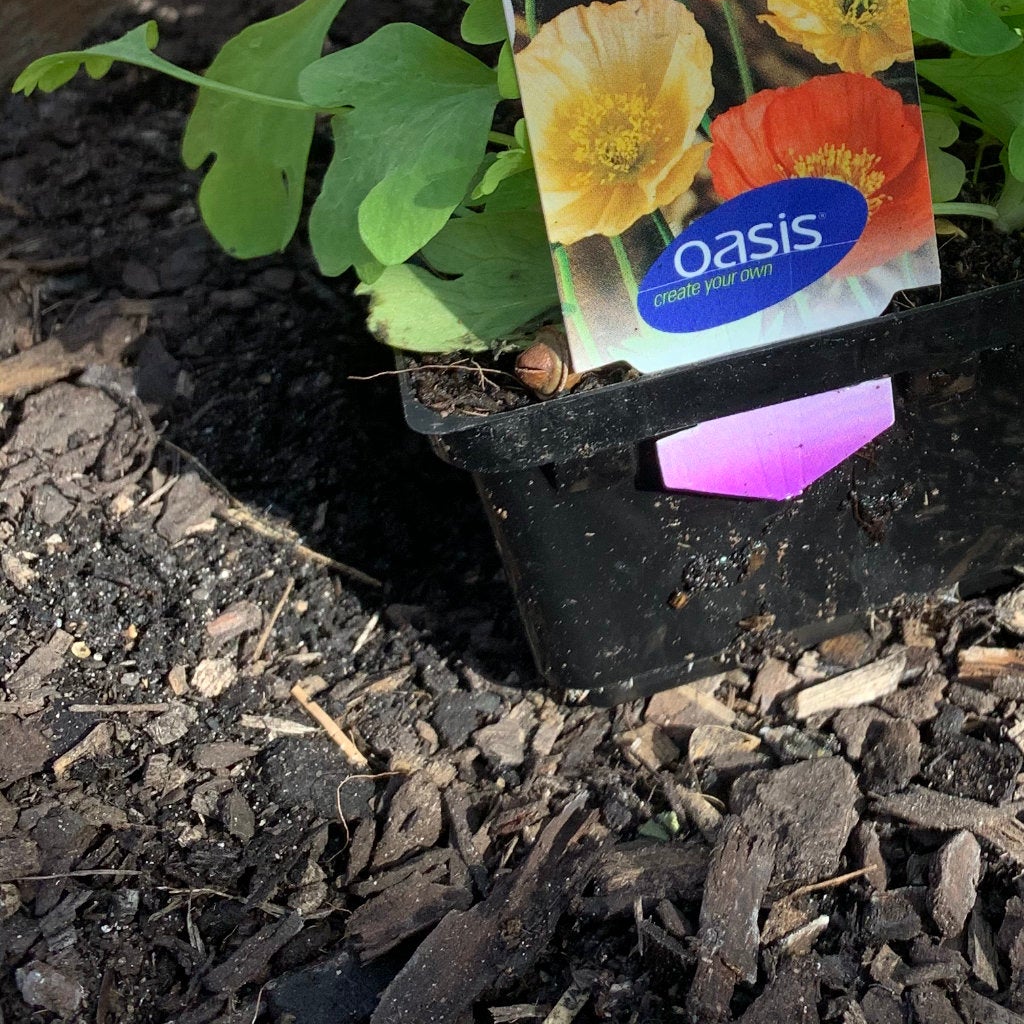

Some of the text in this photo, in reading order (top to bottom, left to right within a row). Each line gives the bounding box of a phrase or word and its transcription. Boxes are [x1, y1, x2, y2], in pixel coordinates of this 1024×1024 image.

[653, 262, 774, 308] create your own
